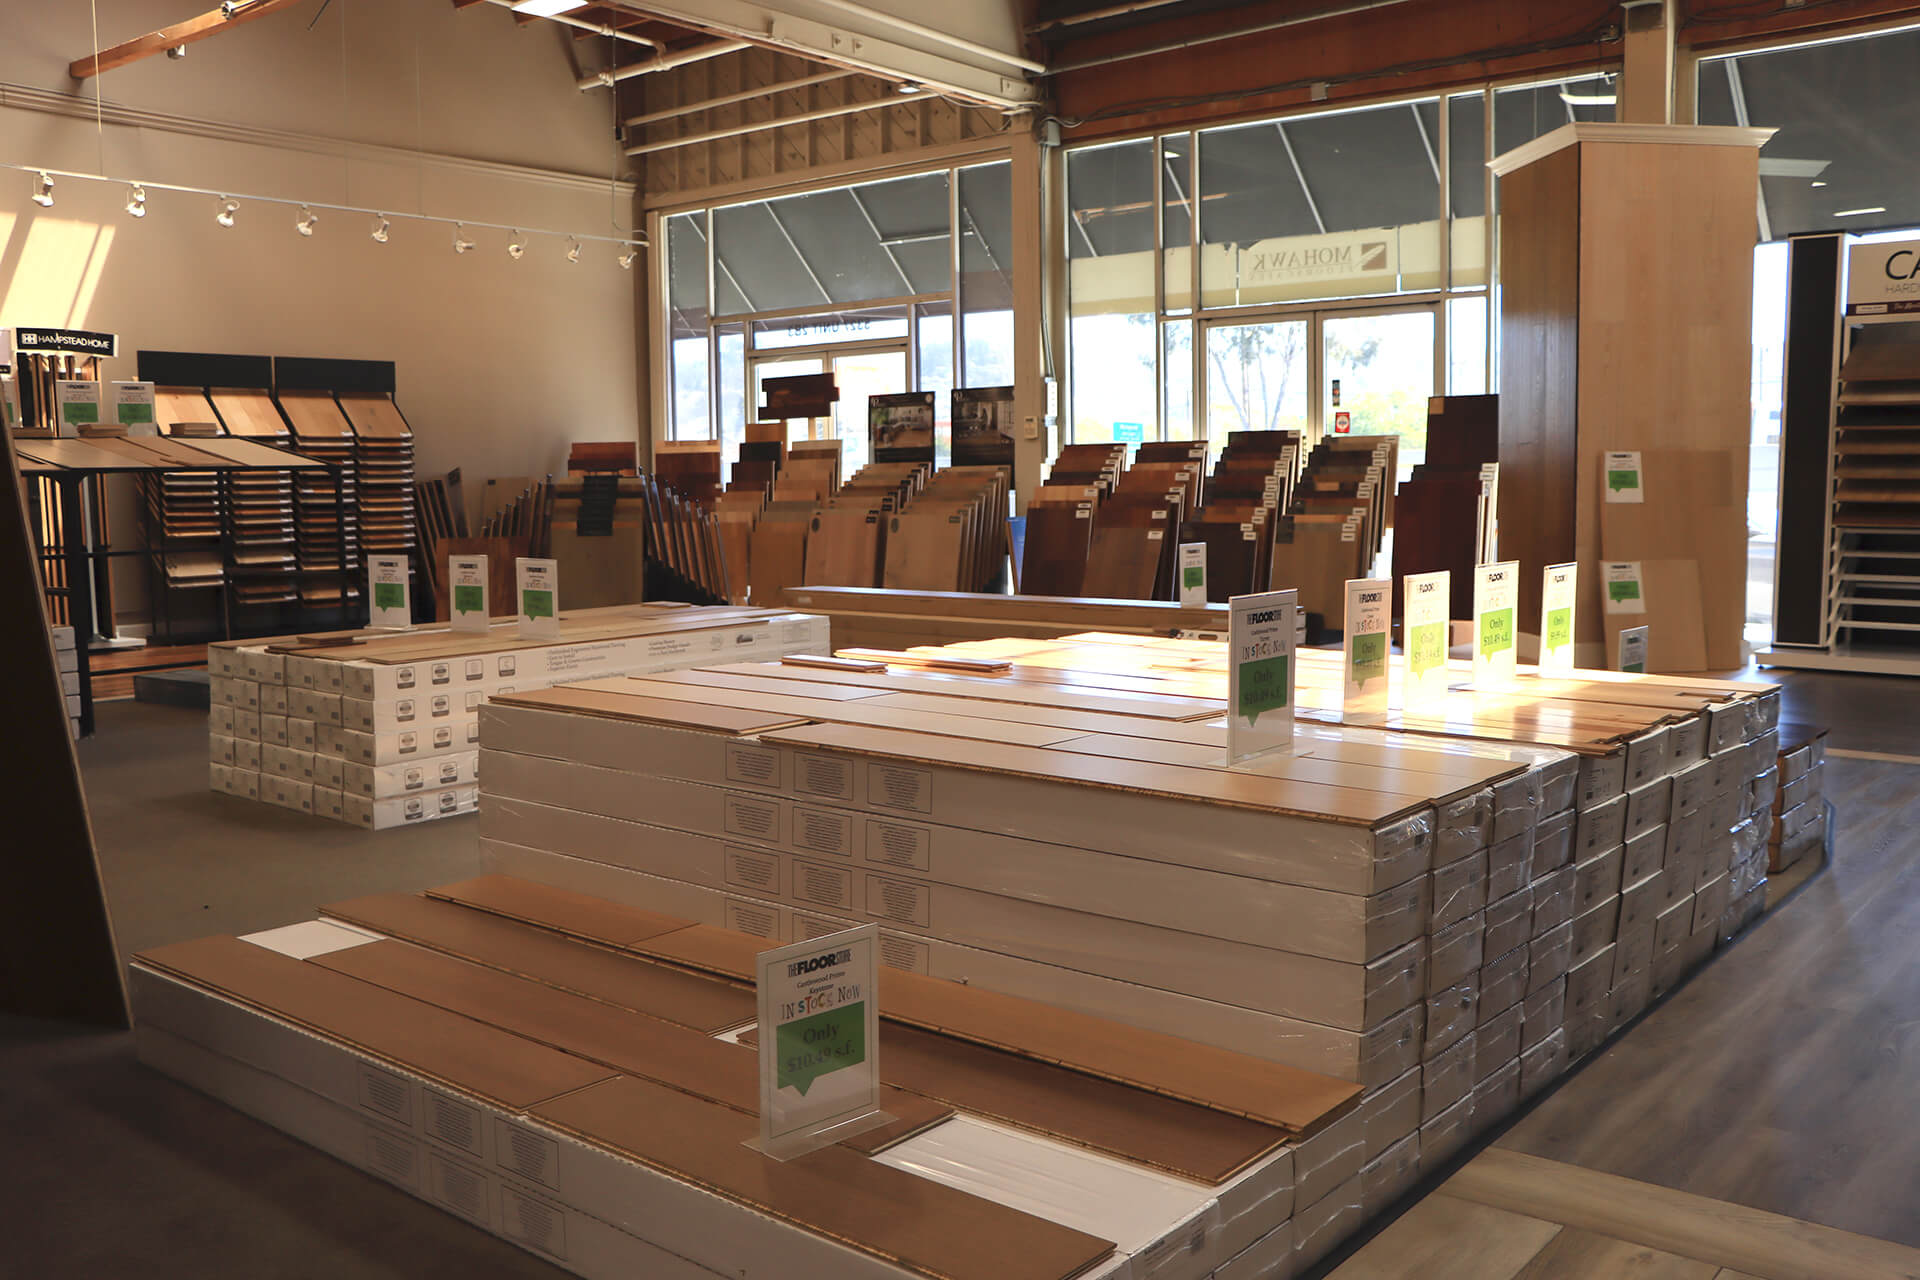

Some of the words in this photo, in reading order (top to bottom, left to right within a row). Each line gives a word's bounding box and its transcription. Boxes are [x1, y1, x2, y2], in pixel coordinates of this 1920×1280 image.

[39, 332, 88, 347] HAMPSTEAD
[88, 339, 110, 350] HOME
[797, 953, 836, 975] FLOOR
[781, 1002, 795, 1019] IN
[802, 1023, 840, 1046] Only
